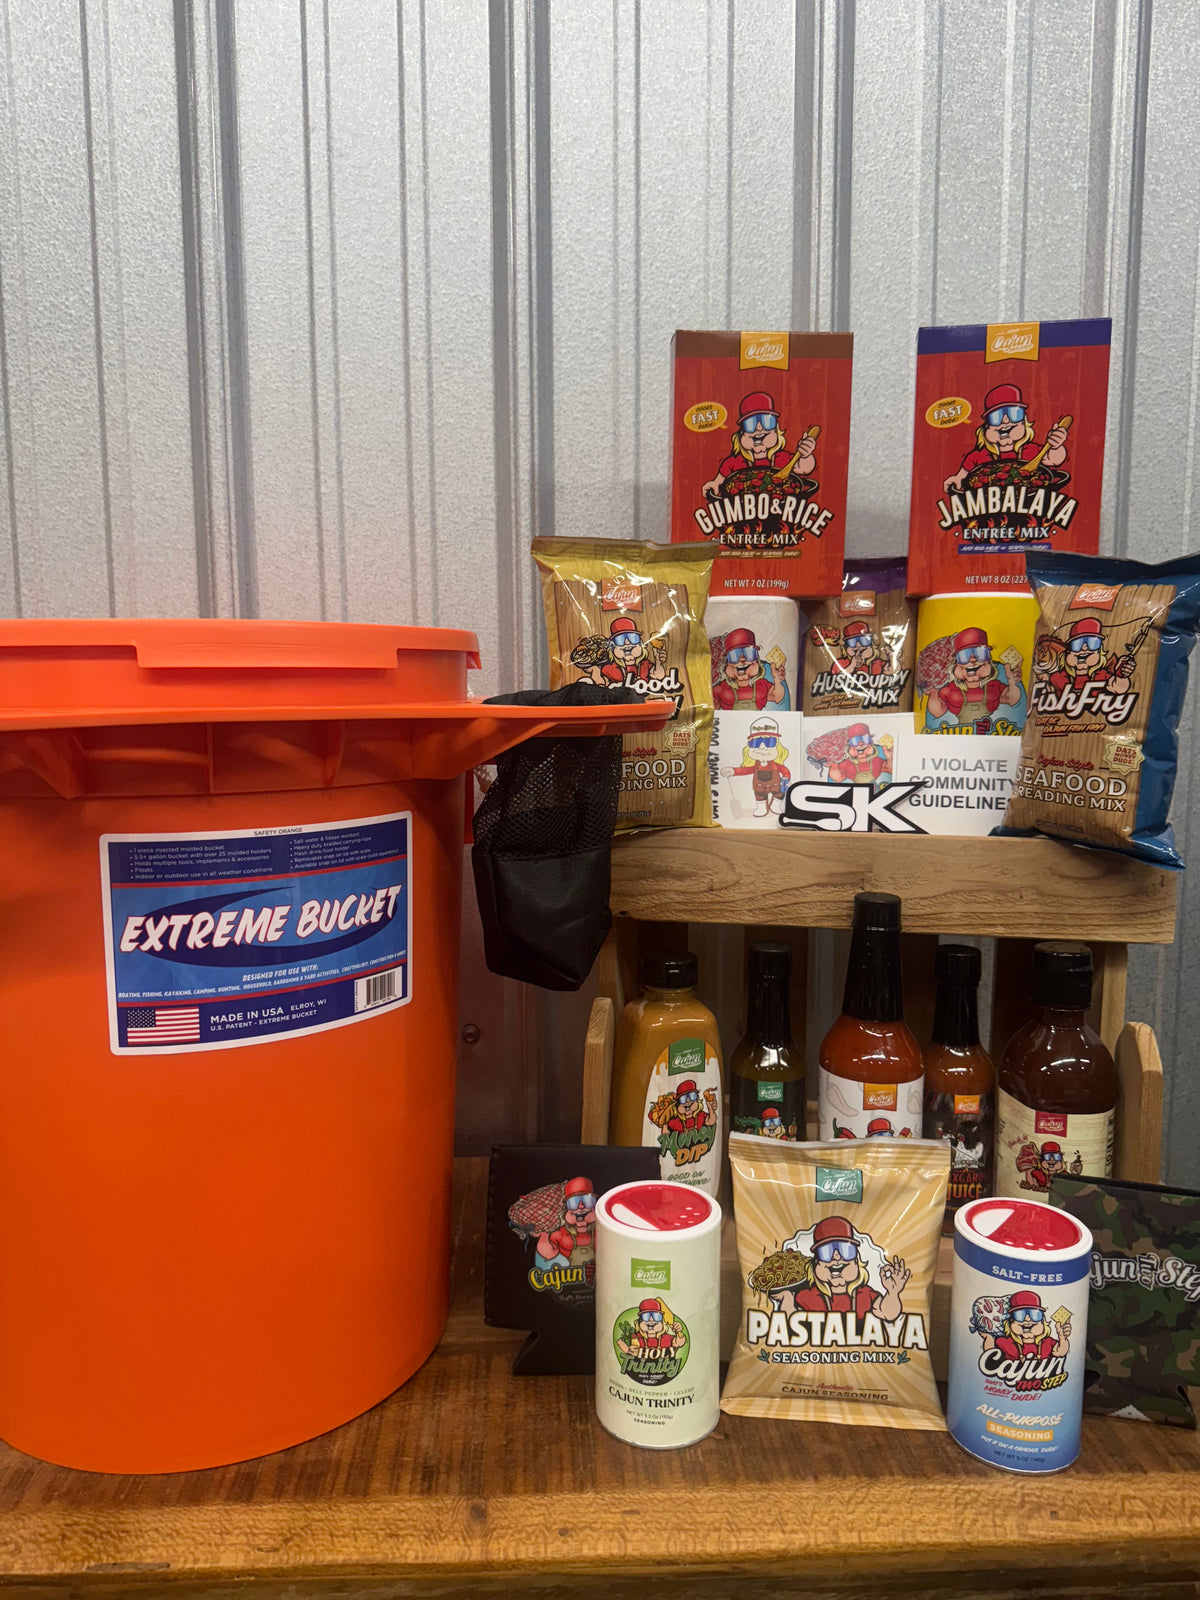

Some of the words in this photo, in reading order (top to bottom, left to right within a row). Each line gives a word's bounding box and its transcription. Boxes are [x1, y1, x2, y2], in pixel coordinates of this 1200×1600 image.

[692, 410, 719, 424] FAST
[934, 406, 962, 420] FAST
[938, 486, 1077, 528] JAMBALAYA
[720, 531, 767, 544] ENTRÉE
[773, 533, 798, 544] MIX
[964, 526, 1014, 539] ENTRÉE
[1021, 527, 1049, 538] MIX
[724, 580, 737, 588] NET
[739, 580, 749, 588] WT
[751, 580, 756, 588] 7
[757, 580, 765, 588] OZ
[767, 580, 789, 589] (199g)
[965, 576, 979, 584] NET
[981, 576, 992, 584] WT
[994, 575, 998, 583] 8
[1000, 575, 1010, 583] OZ
[1012, 575, 1028, 585] (227
[864, 688, 900, 706] MIX
[1117, 747, 1137, 755] DATS
[622, 759, 686, 778] FOOD
[922, 758, 925, 770] I
[931, 758, 1008, 772] VIOLATE
[1065, 759, 1095, 771] Style
[658, 776, 687, 789] MIX
[1016, 766, 1127, 796] SEAFOOD
[785, 782, 925, 832] SK
[909, 794, 1010, 810] GUIDELINE
[1015, 785, 1085, 807] READING
[1089, 797, 1126, 812] MIX
[119, 905, 292, 952] EXTREME
[296, 884, 403, 938] BUCKET
[242, 971, 273, 982] DESIGNED
[274, 969, 287, 977] FOR
[288, 967, 299, 975] USE
[301, 964, 319, 973] WITH:
[210, 1012, 243, 1024] MADE
[247, 1010, 259, 1019] IN
[262, 1007, 284, 1017] USA
[290, 1001, 315, 1011] ELROY,
[226, 1021, 252, 1029] PATENT
[259, 1015, 290, 1025] EXTREME
[291, 1009, 318, 1020] BUCKET
[675, 1144, 708, 1166] DIP
[947, 1183, 982, 1201] JUICE
[530, 1265, 583, 1290] Cajun
[992, 1265, 1063, 1282] SALT-FREE
[1090, 1254, 1136, 1288] jun
[748, 1310, 927, 1349] PASTALAYA
[638, 1346, 676, 1359] HOLY
[772, 1351, 860, 1364] SEASONING
[863, 1351, 895, 1363] MIX
[620, 1354, 682, 1378] Trinity
[979, 1348, 1065, 1386] Cajun
[1016, 1380, 1041, 1390] TWO
[1041, 1373, 1068, 1390] STEP
[609, 1386, 643, 1406] CAJUN
[646, 1394, 694, 1408] TRINITY
[782, 1386, 818, 1395] CAJUN
[822, 1390, 888, 1400] SEASONING
[984, 1386, 1014, 1395] MONEY
[1010, 1393, 1043, 1401] DUDE!
[976, 1404, 1064, 1426] ALL-PURPOSE
[990, 1423, 1051, 1439] SEASONING
